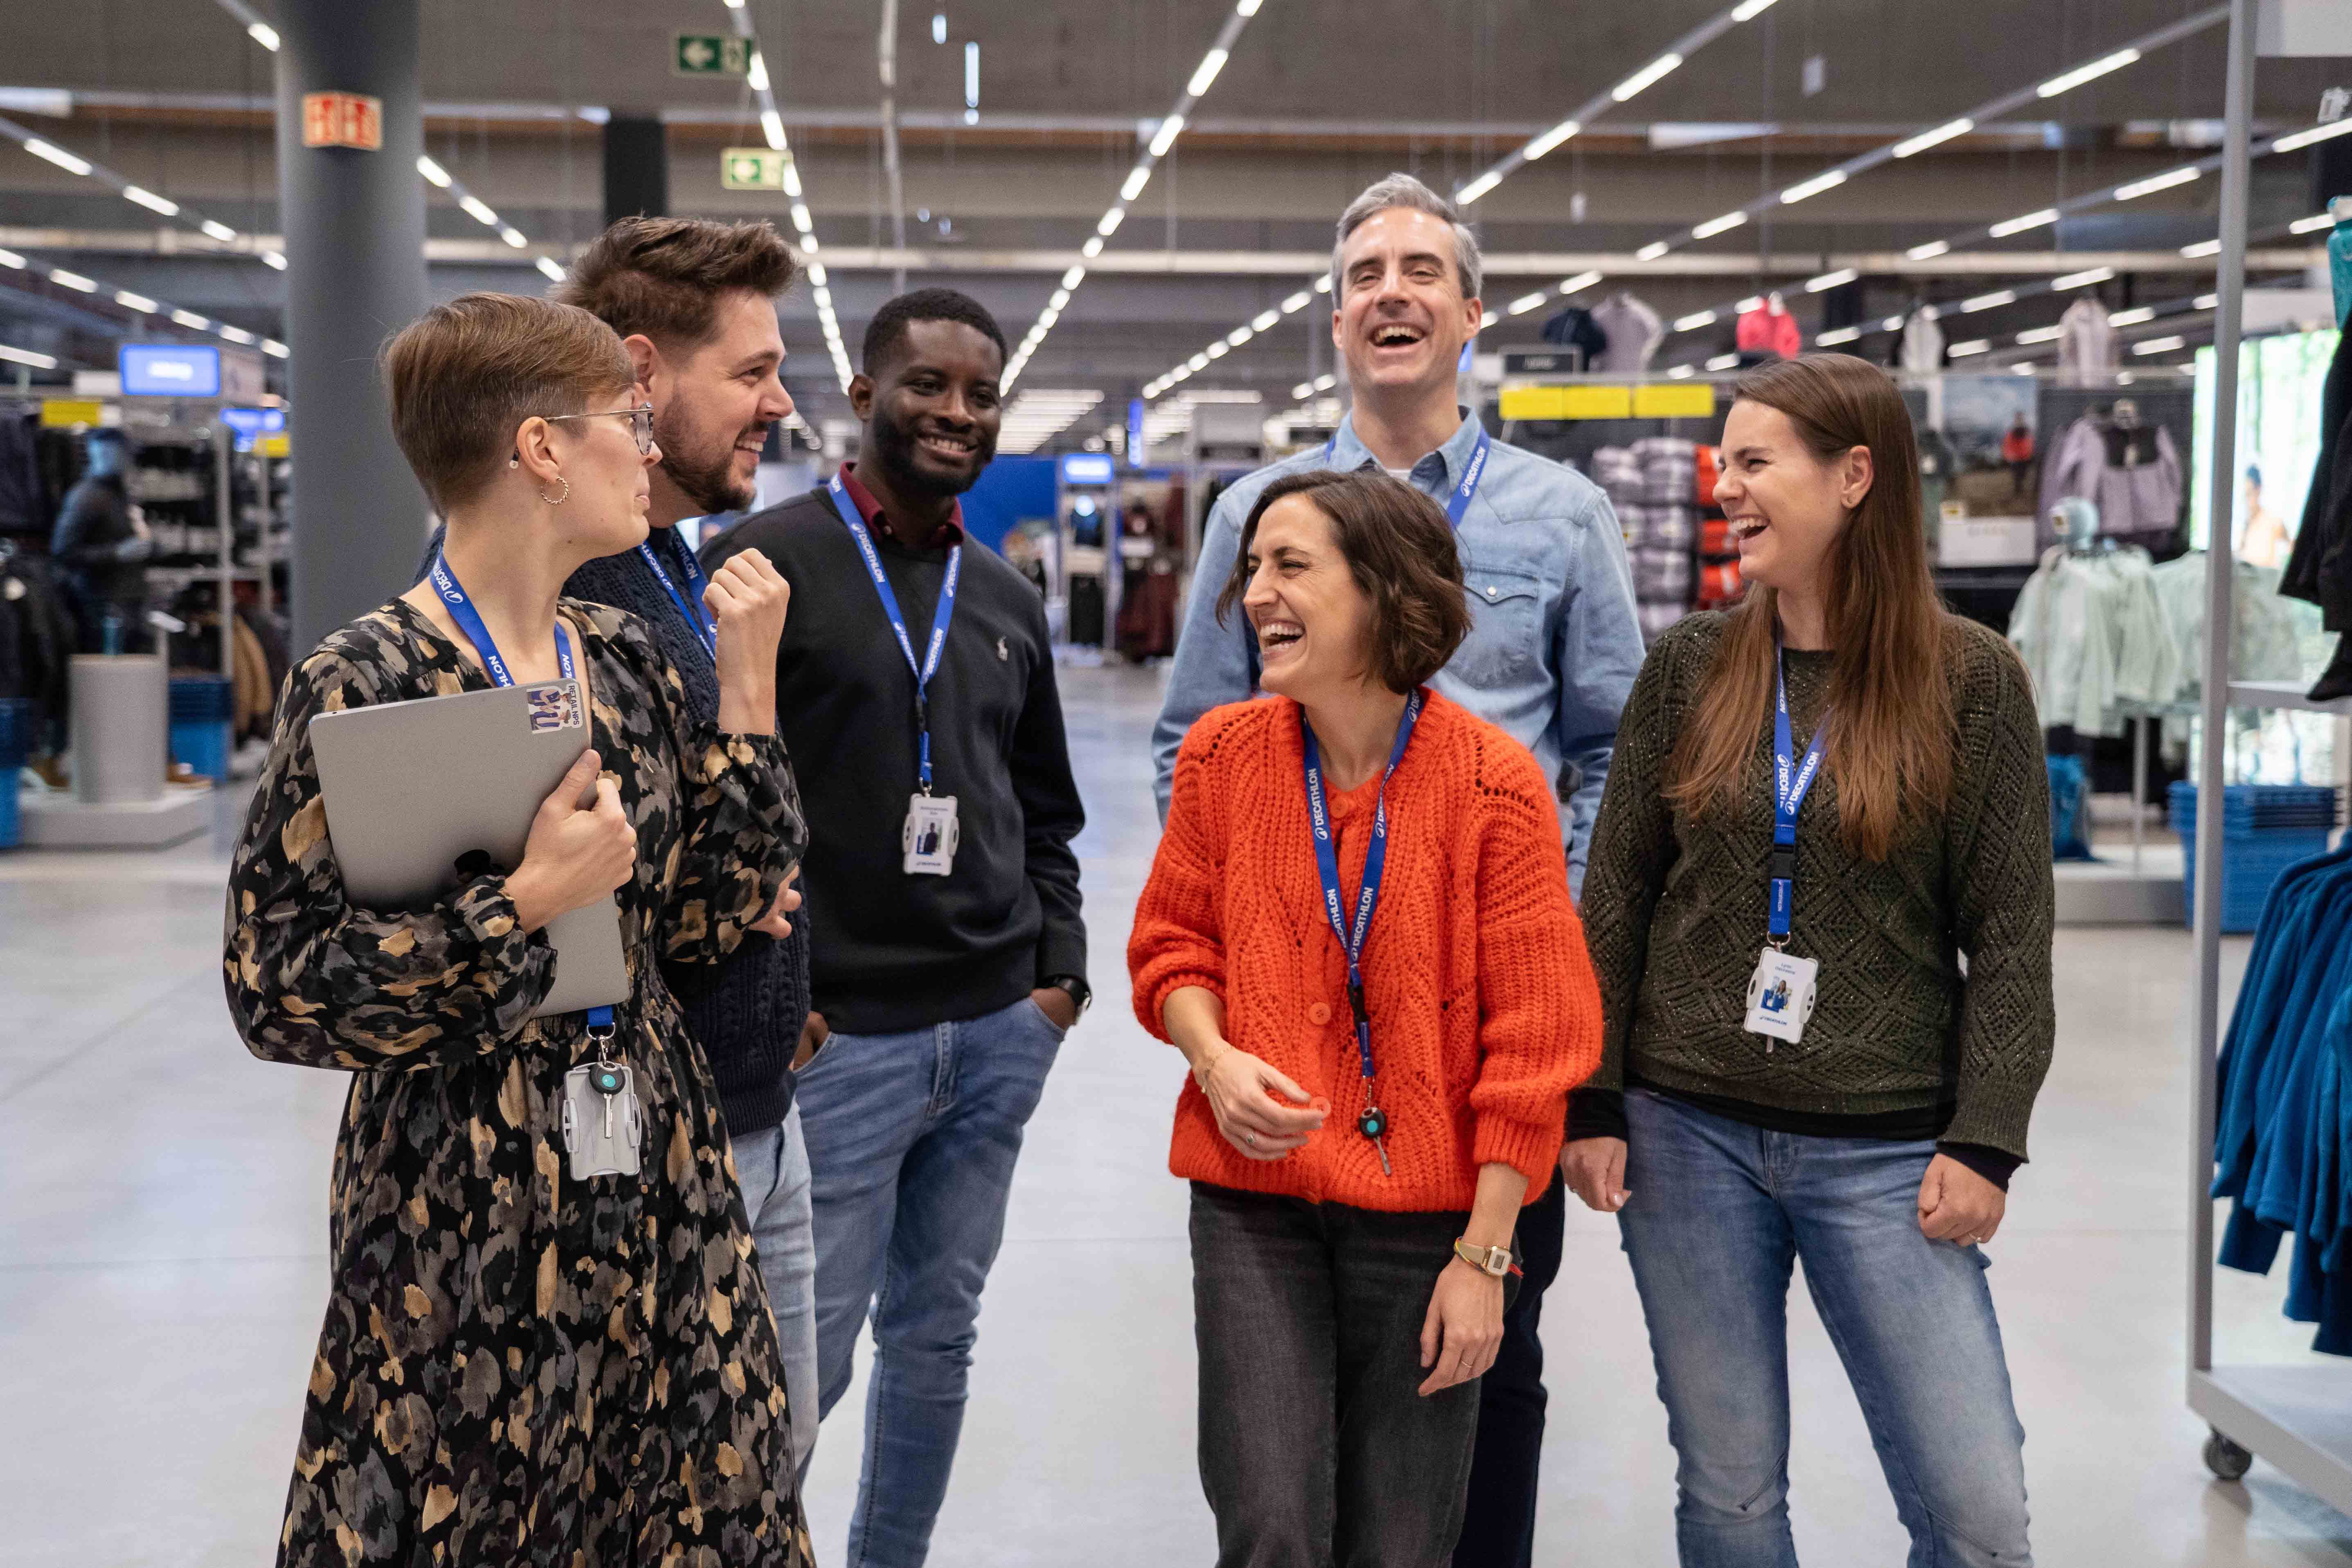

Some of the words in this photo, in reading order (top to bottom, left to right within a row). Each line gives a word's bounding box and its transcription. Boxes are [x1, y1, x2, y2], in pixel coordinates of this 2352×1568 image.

[568, 685, 577, 711] RETAIL
[1308, 768, 1324, 826] DECATHLON
[1789, 751, 1821, 802] DECATHLON
[1354, 887, 1373, 946] DECATHLON
